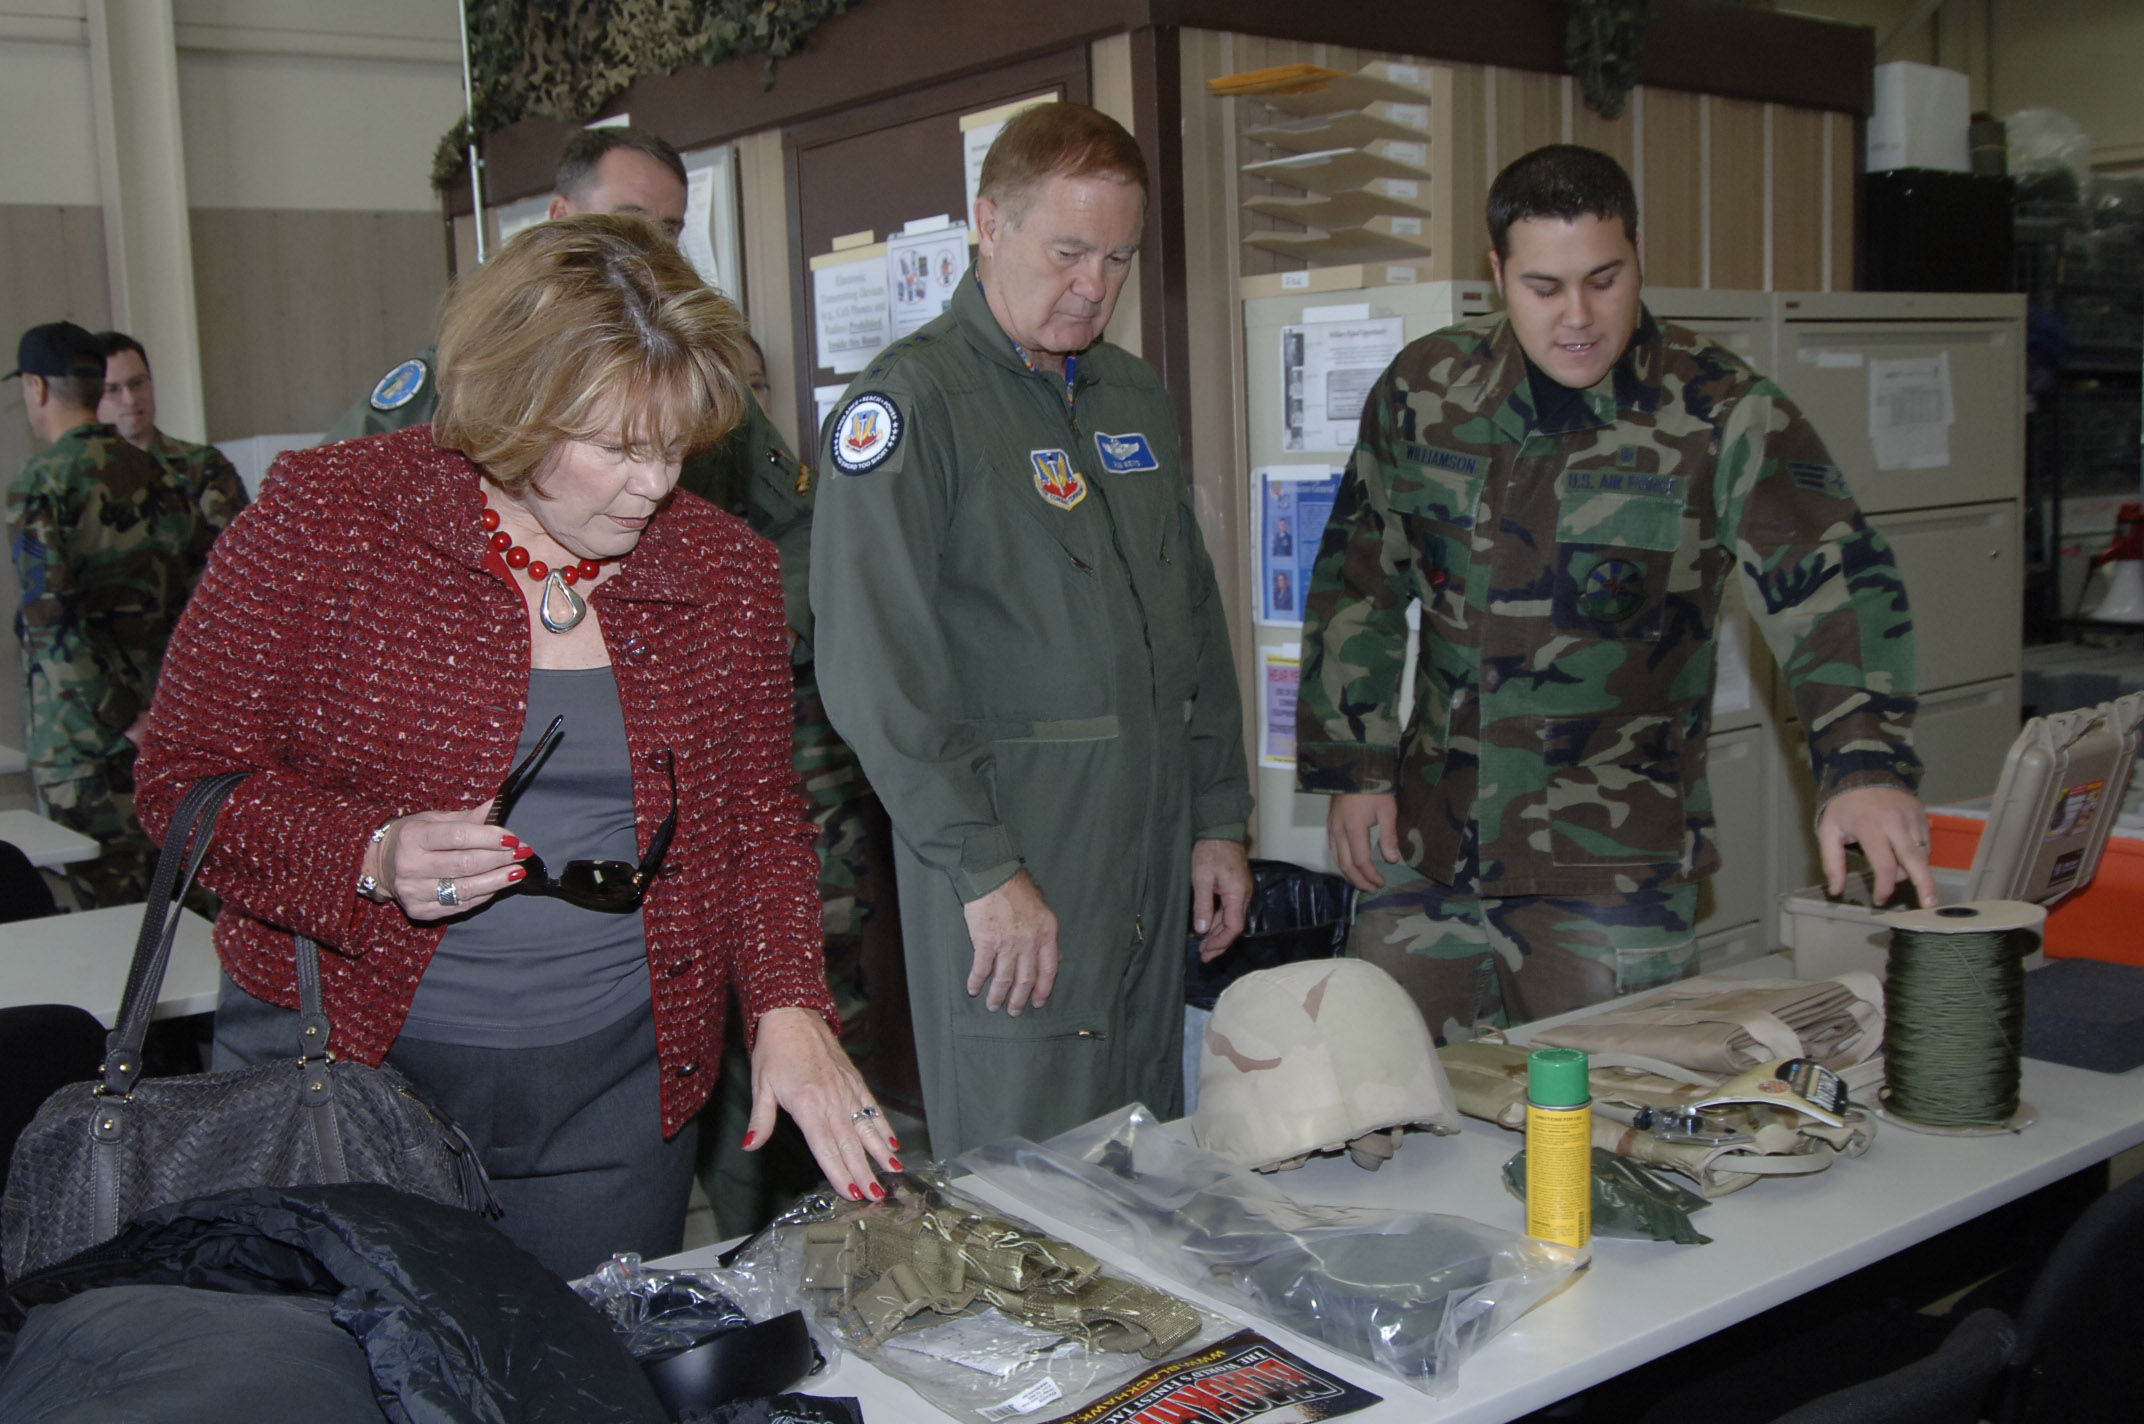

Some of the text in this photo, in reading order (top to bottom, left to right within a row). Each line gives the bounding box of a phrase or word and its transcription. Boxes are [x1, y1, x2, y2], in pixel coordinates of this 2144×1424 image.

[883, 401, 897, 420] POWER
[870, 448, 888, 464] SHORT
[1407, 445, 1477, 473] WILLIAMSON
[1568, 474, 1594, 489] U.S.
[1600, 474, 1624, 489] AIR
[1243, 1350, 1269, 1366] THE
[1180, 1361, 1241, 1382] WORLD'S
[1132, 1380, 1183, 1408] FINEST
